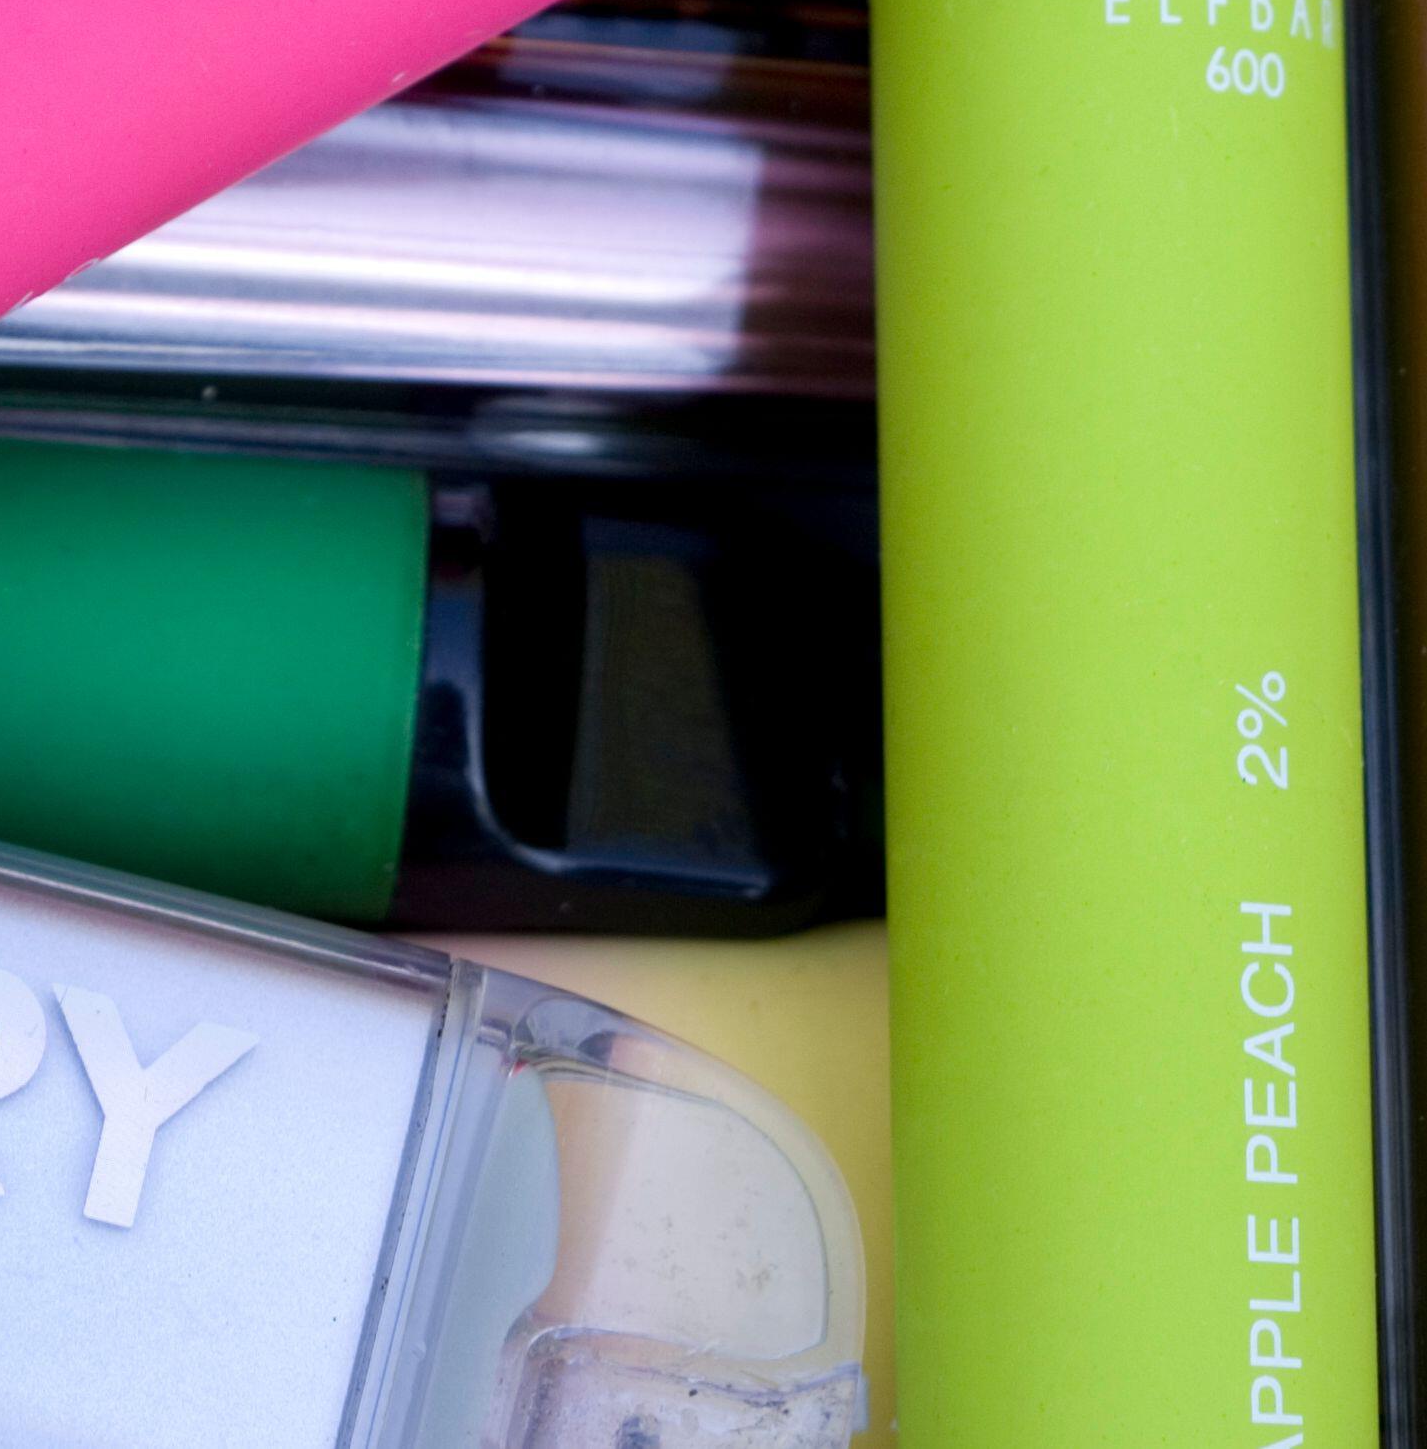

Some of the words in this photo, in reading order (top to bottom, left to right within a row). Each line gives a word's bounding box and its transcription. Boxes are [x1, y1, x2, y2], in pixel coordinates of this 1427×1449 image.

[1206, 47, 1285, 98] 600
[1234, 671, 1289, 790] 2%
[1239, 901, 1298, 1184] PEACH
